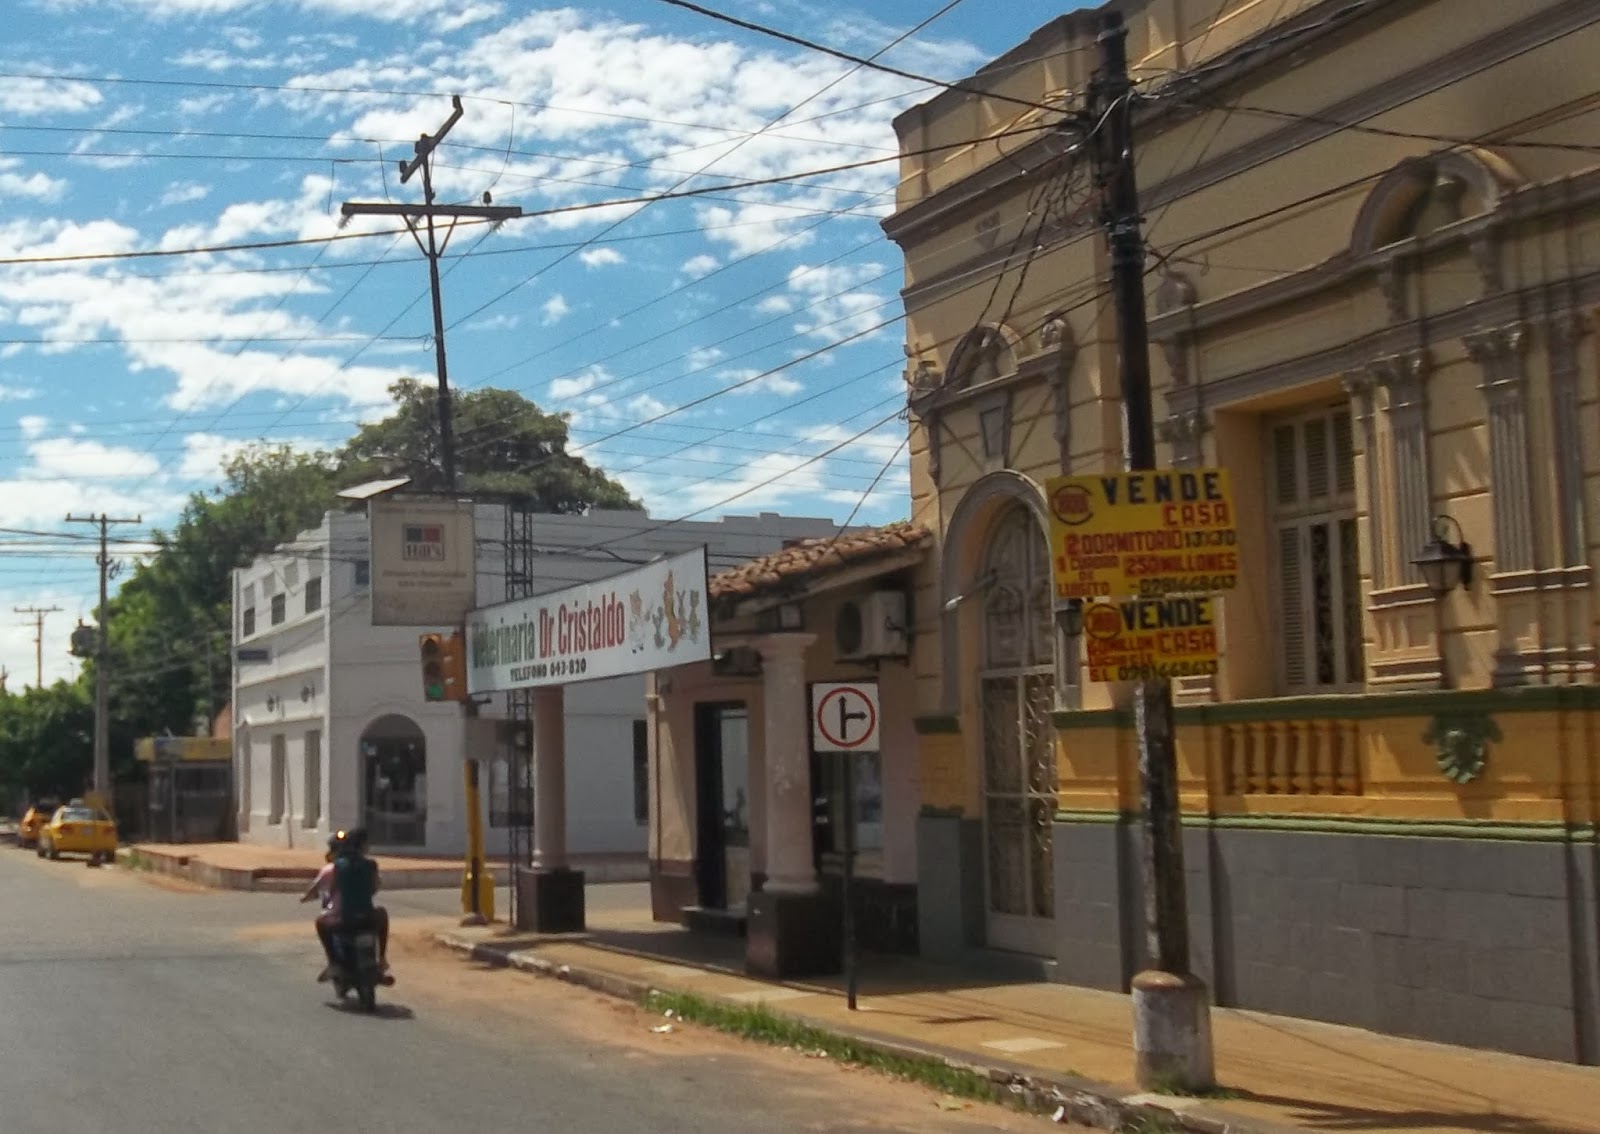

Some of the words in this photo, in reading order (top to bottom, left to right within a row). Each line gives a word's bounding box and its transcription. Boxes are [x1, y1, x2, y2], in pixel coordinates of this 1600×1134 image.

[1101, 472, 1223, 506] VENDE
[1163, 501, 1231, 528] CASA
[539, 607, 557, 659] Dr.
[558, 591, 626, 654] Cristaldo
[1120, 599, 1213, 630] VENDE
[1159, 629, 1217, 655] CASA
[510, 664, 548, 682] TELEFONO
